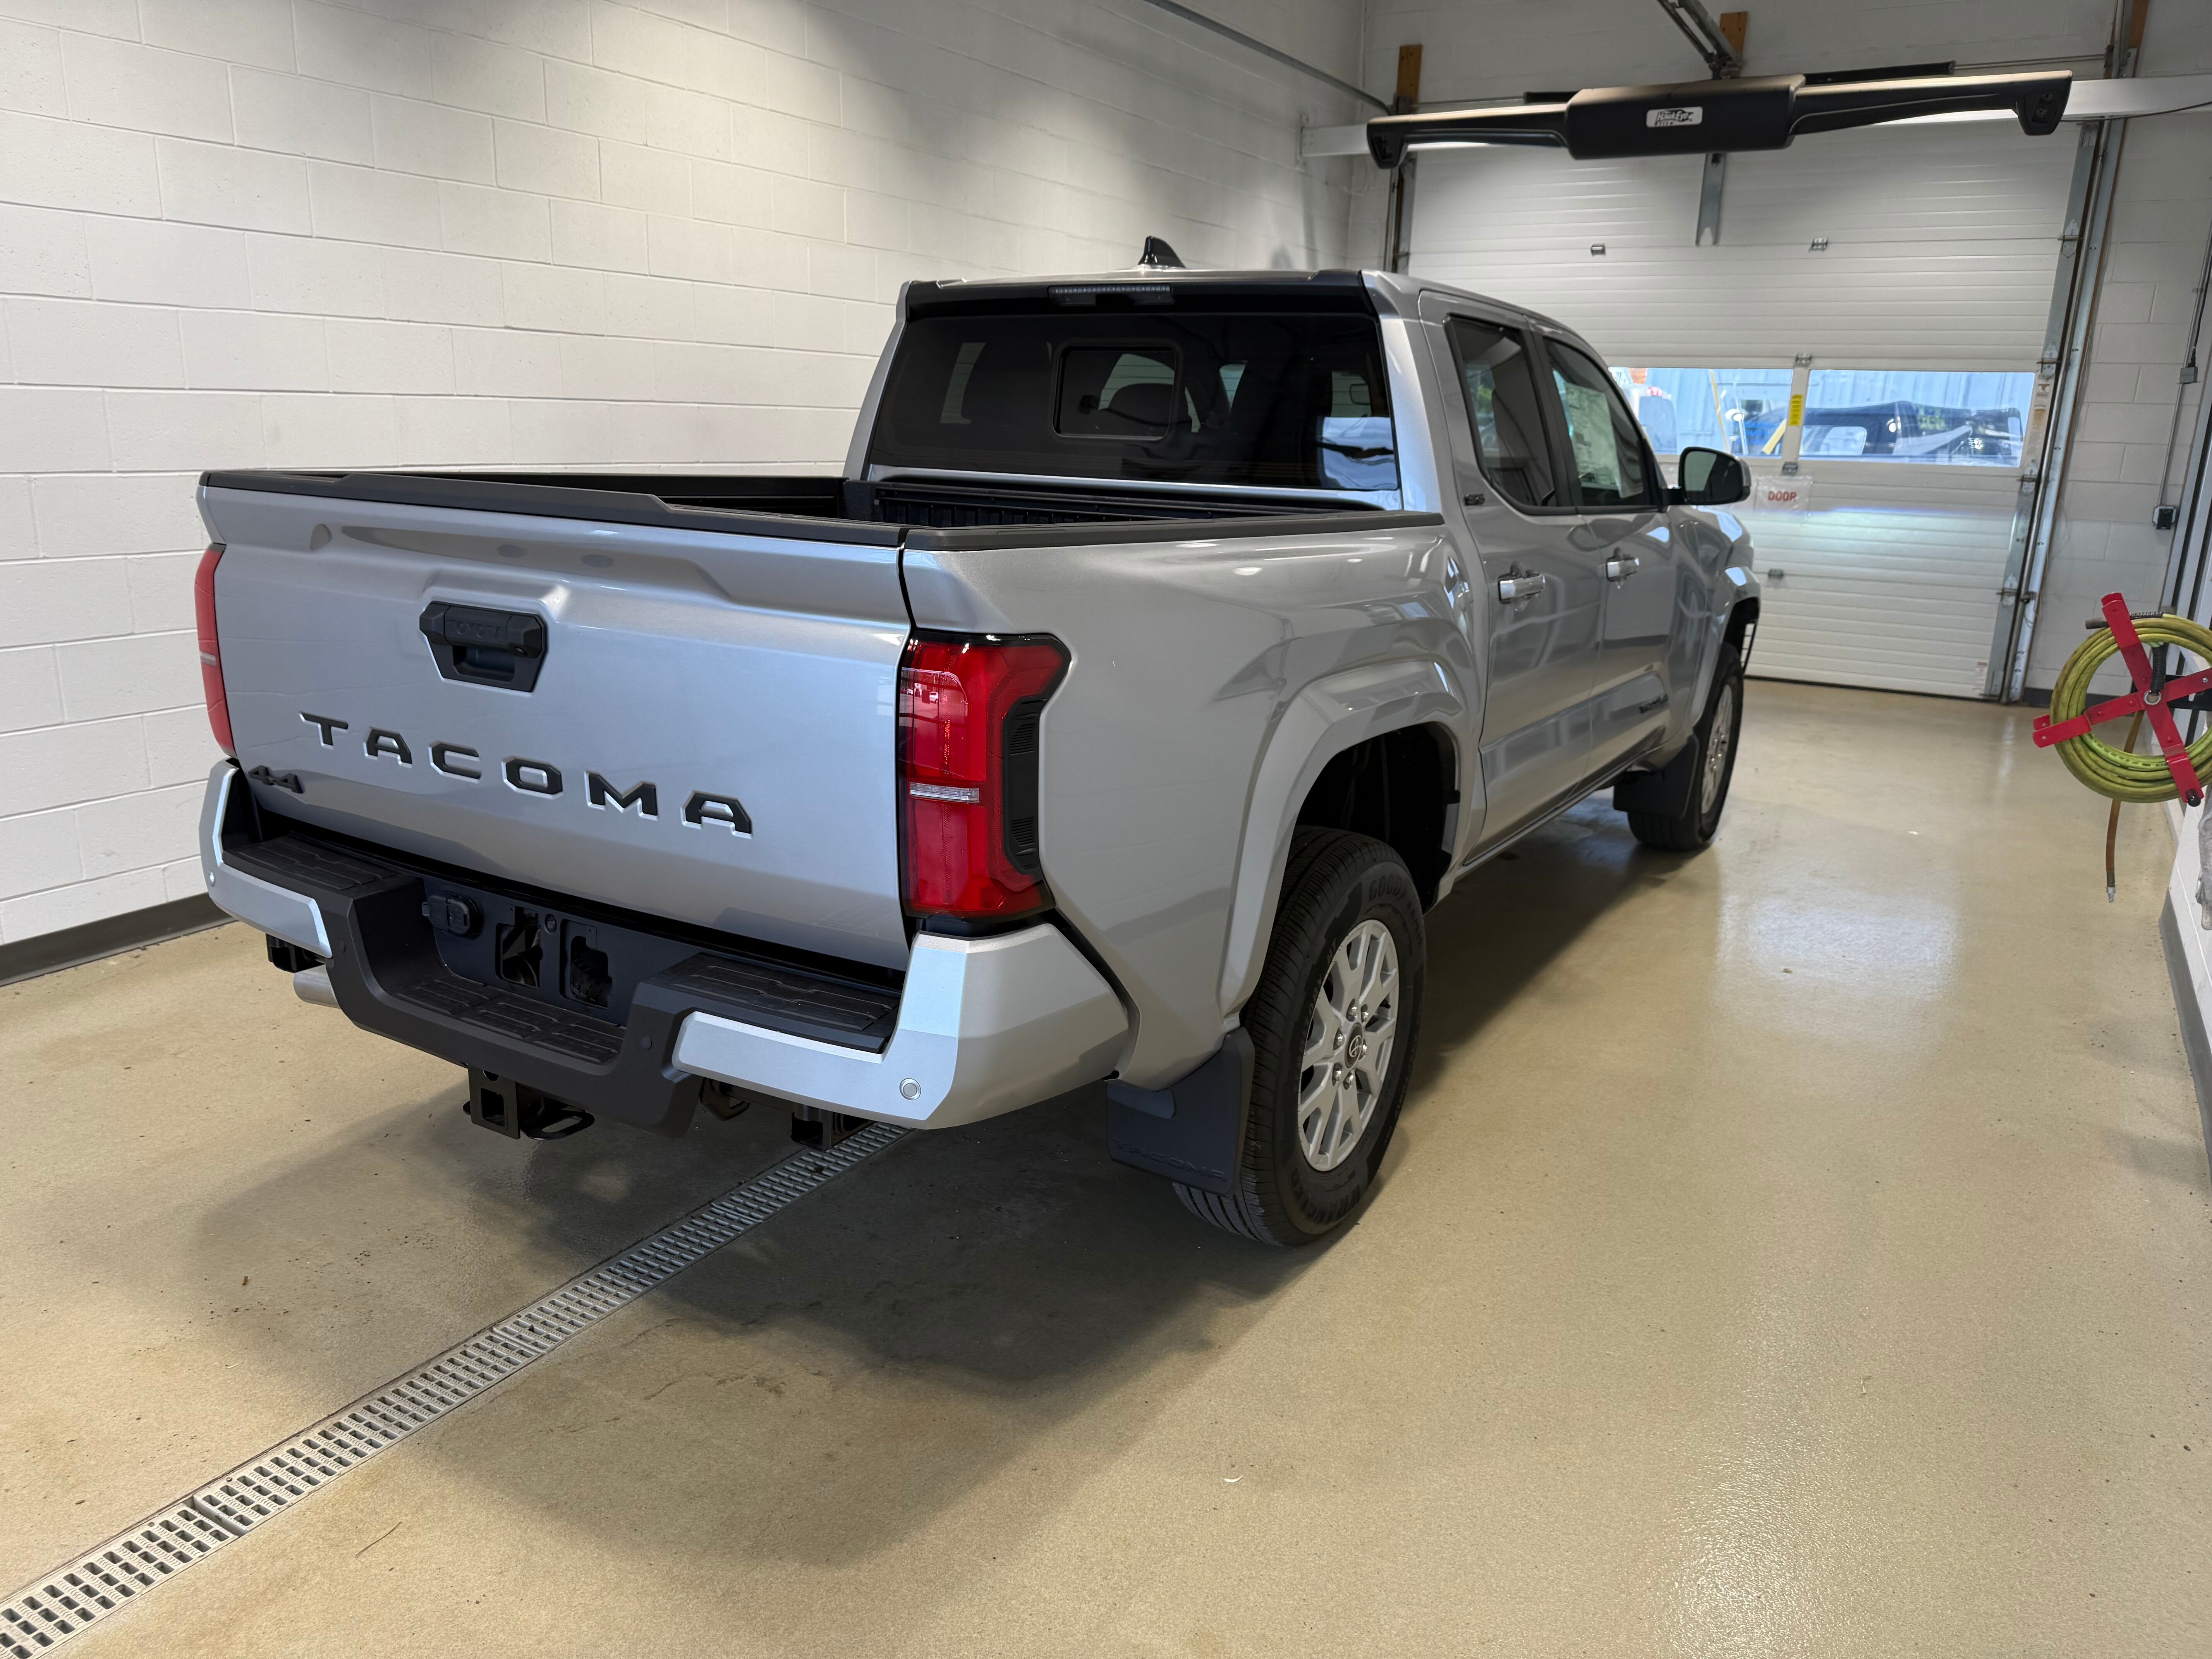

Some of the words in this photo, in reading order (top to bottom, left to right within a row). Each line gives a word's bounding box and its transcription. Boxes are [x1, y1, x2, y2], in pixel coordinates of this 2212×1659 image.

[1767, 491, 1797, 502] DOOR
[448, 619, 505, 641] TOYOTA
[300, 711, 753, 837] TACOMA
[1111, 1139, 1227, 1182] TACOMA
